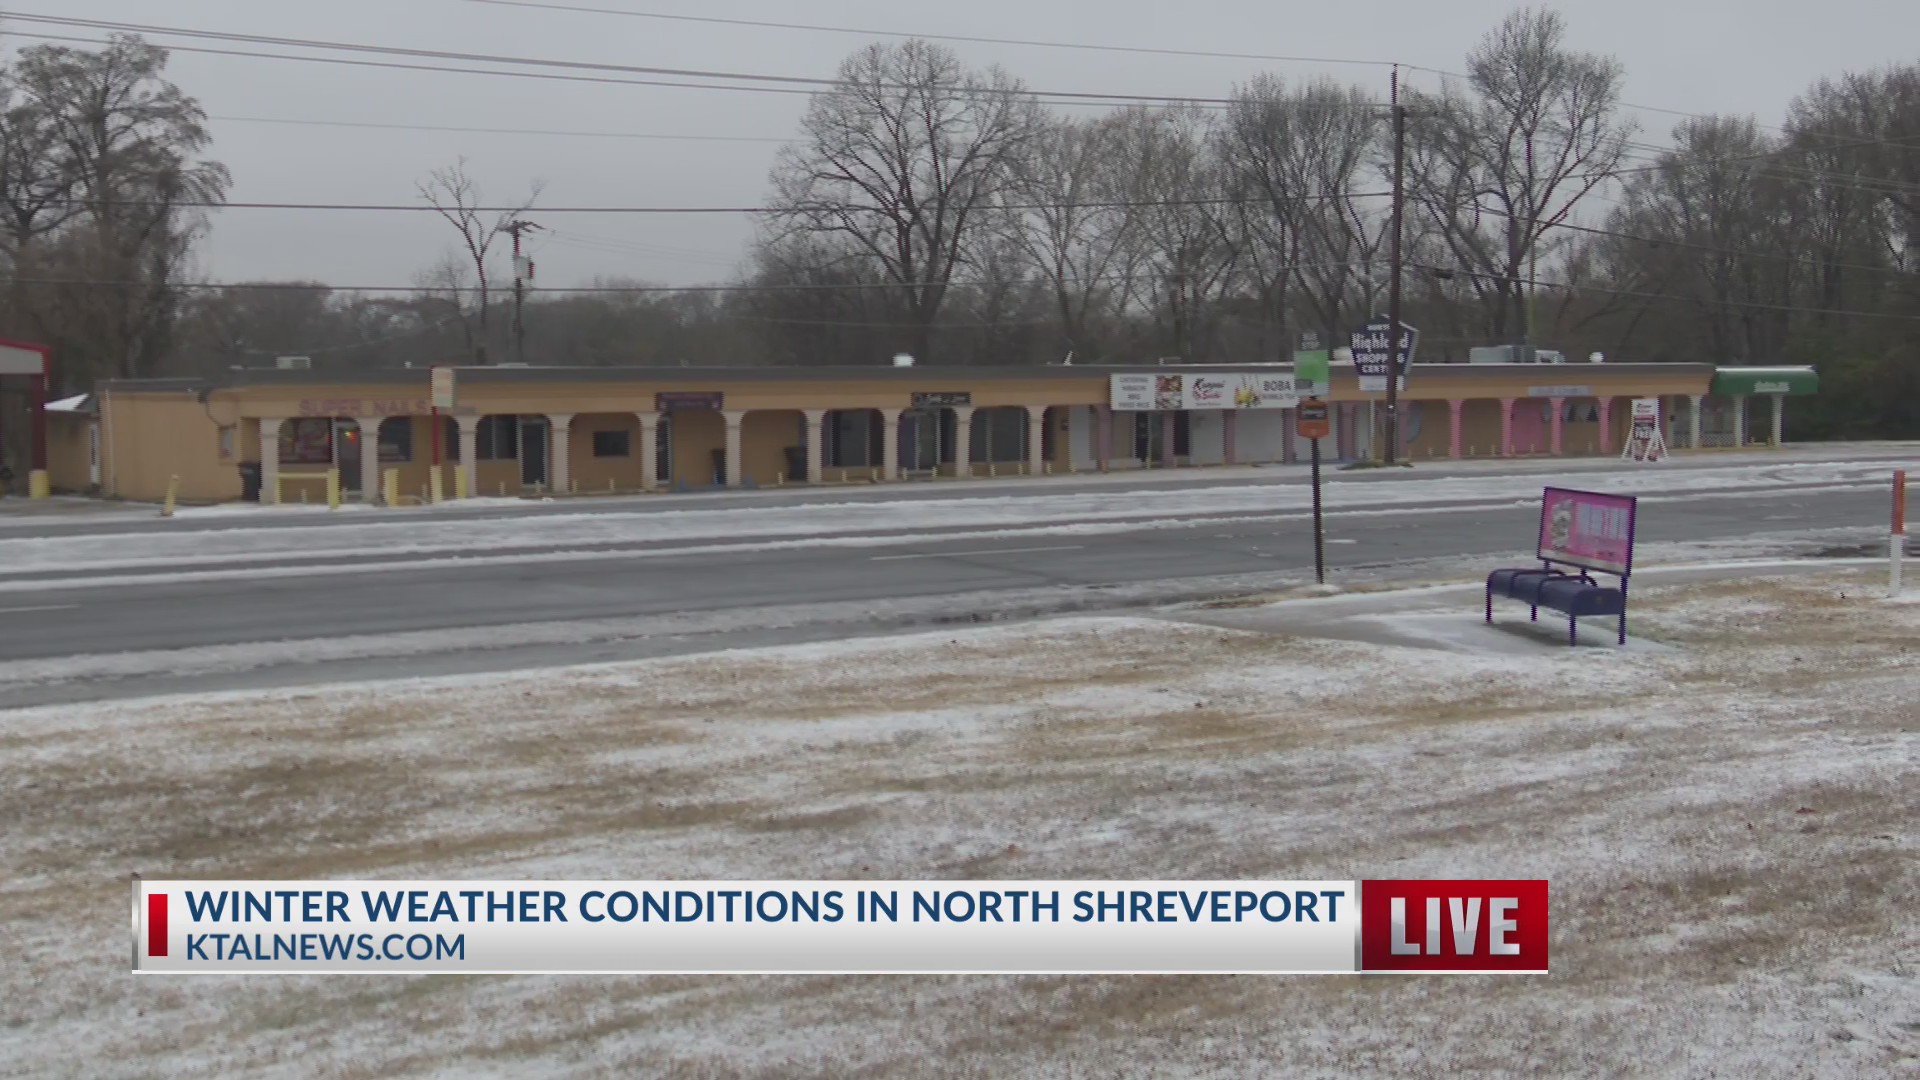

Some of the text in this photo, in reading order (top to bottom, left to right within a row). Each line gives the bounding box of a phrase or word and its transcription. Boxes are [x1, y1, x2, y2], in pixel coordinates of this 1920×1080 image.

[1355, 353, 1405, 363] SHOPPG
[1263, 380, 1292, 391] BOBA
[300, 398, 361, 417] SUPER
[374, 398, 430, 417] NAILS
